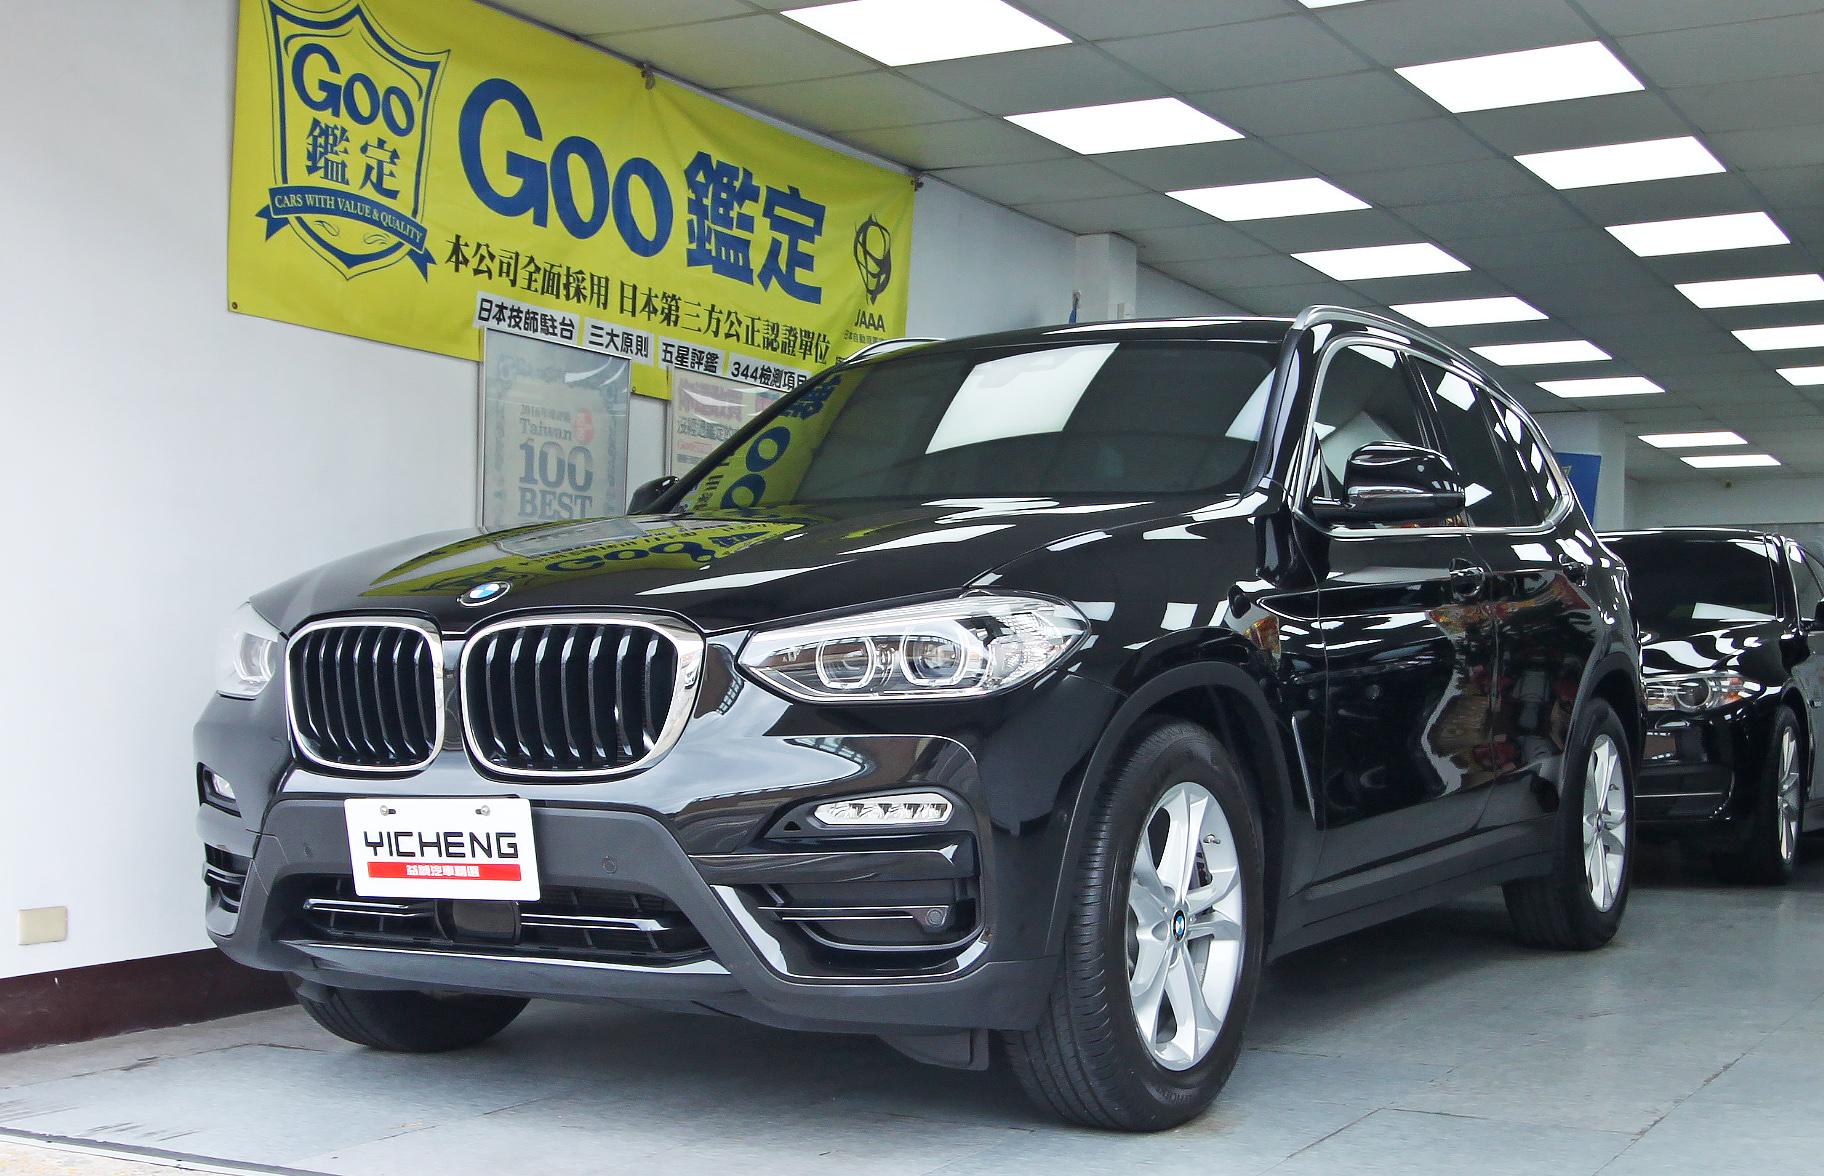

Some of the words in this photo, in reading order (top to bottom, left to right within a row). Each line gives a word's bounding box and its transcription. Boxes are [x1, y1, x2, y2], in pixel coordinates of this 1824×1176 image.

[304, 116, 401, 201] 鑑定
[274, 193, 303, 208] CARS
[305, 194, 336, 209] WITH
[337, 199, 373, 217] VALUE
[372, 210, 380, 220] &
[380, 212, 423, 243] QUALITY
[683, 151, 826, 304] 鑑定
[445, 233, 610, 311] 本公司全面採用
[619, 279, 832, 365] 日本第三方公正認證單位
[477, 297, 575, 341] 日本技師駐台
[854, 308, 886, 332] JAAA
[588, 323, 649, 359] 三大原則
[661, 341, 720, 374] 五星評鑑
[519, 417, 573, 441] Taiwan
[519, 439, 594, 493] 100
[518, 486, 594, 520] BEST
[363, 831, 519, 858] YICHENG
